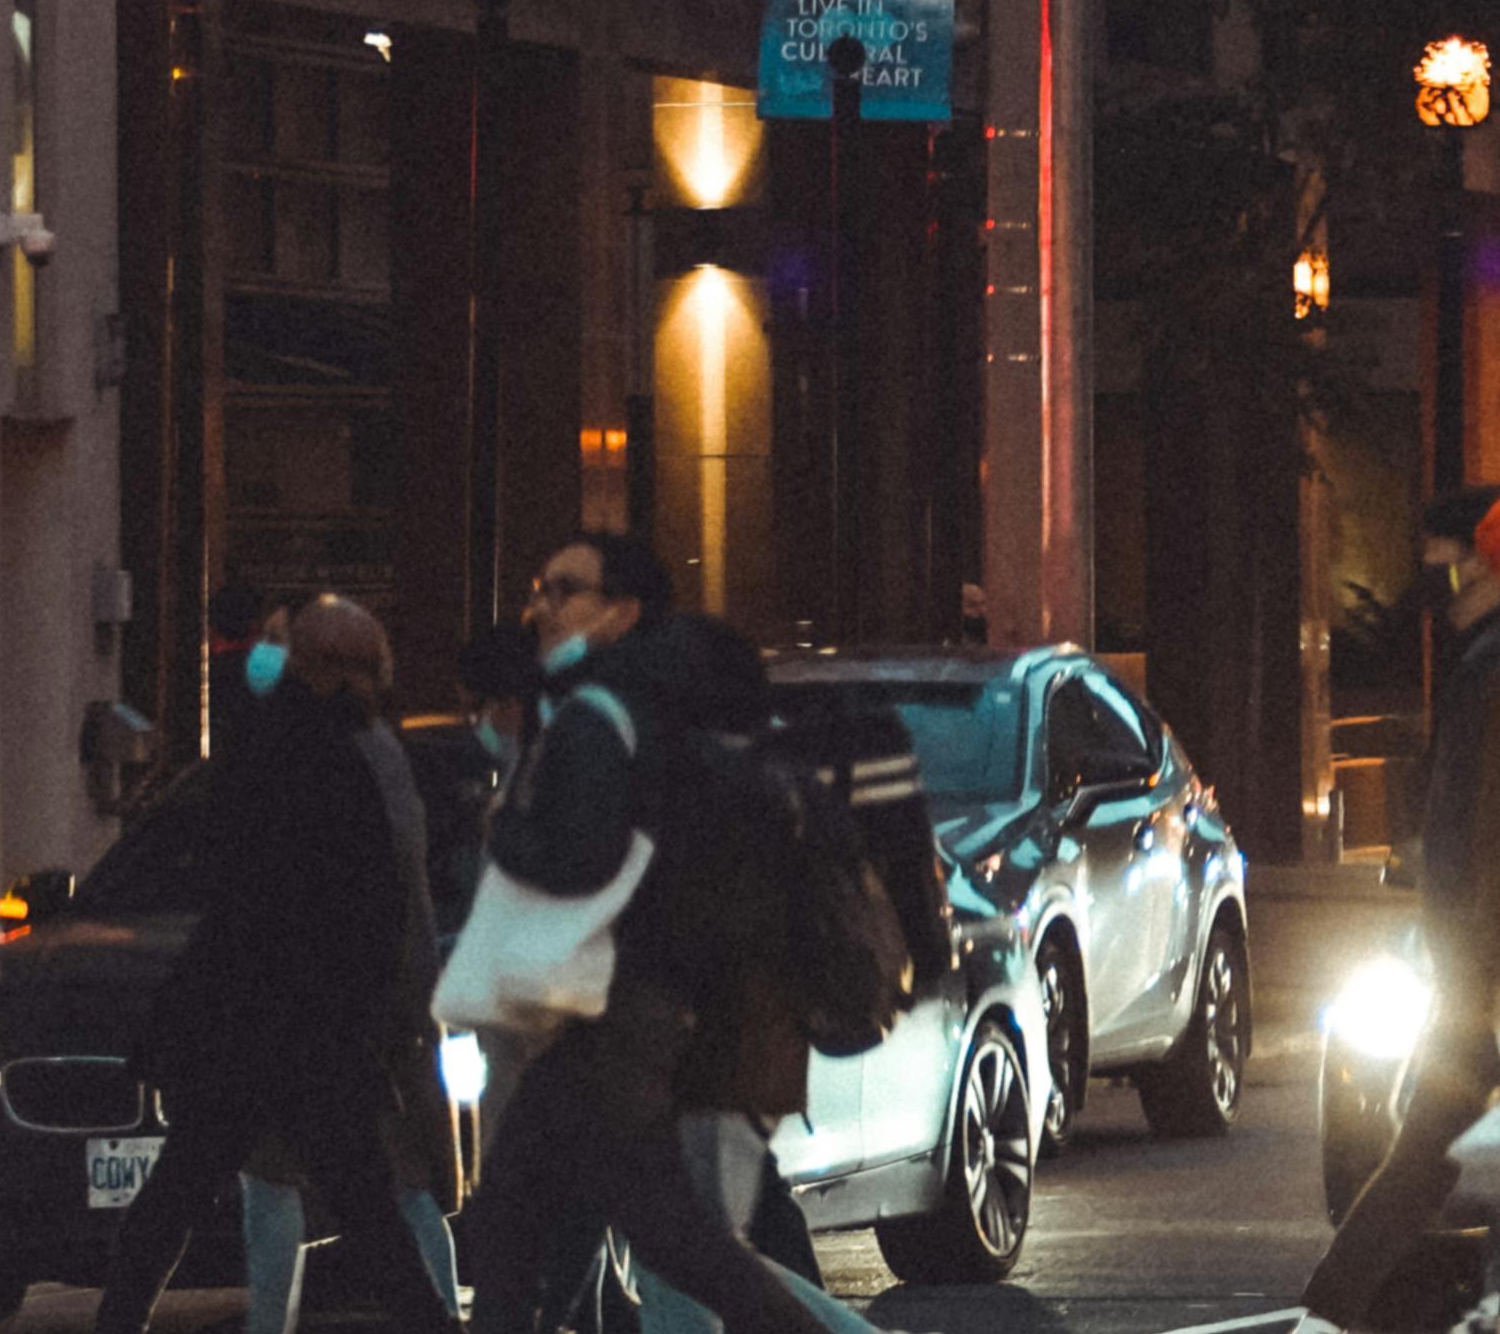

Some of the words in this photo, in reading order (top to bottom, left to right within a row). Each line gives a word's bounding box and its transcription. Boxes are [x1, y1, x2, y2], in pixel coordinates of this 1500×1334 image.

[786, 18, 928, 42] TORONTO'S
[780, 42, 908, 64] CULRAL
[850, 67, 923, 88] EART
